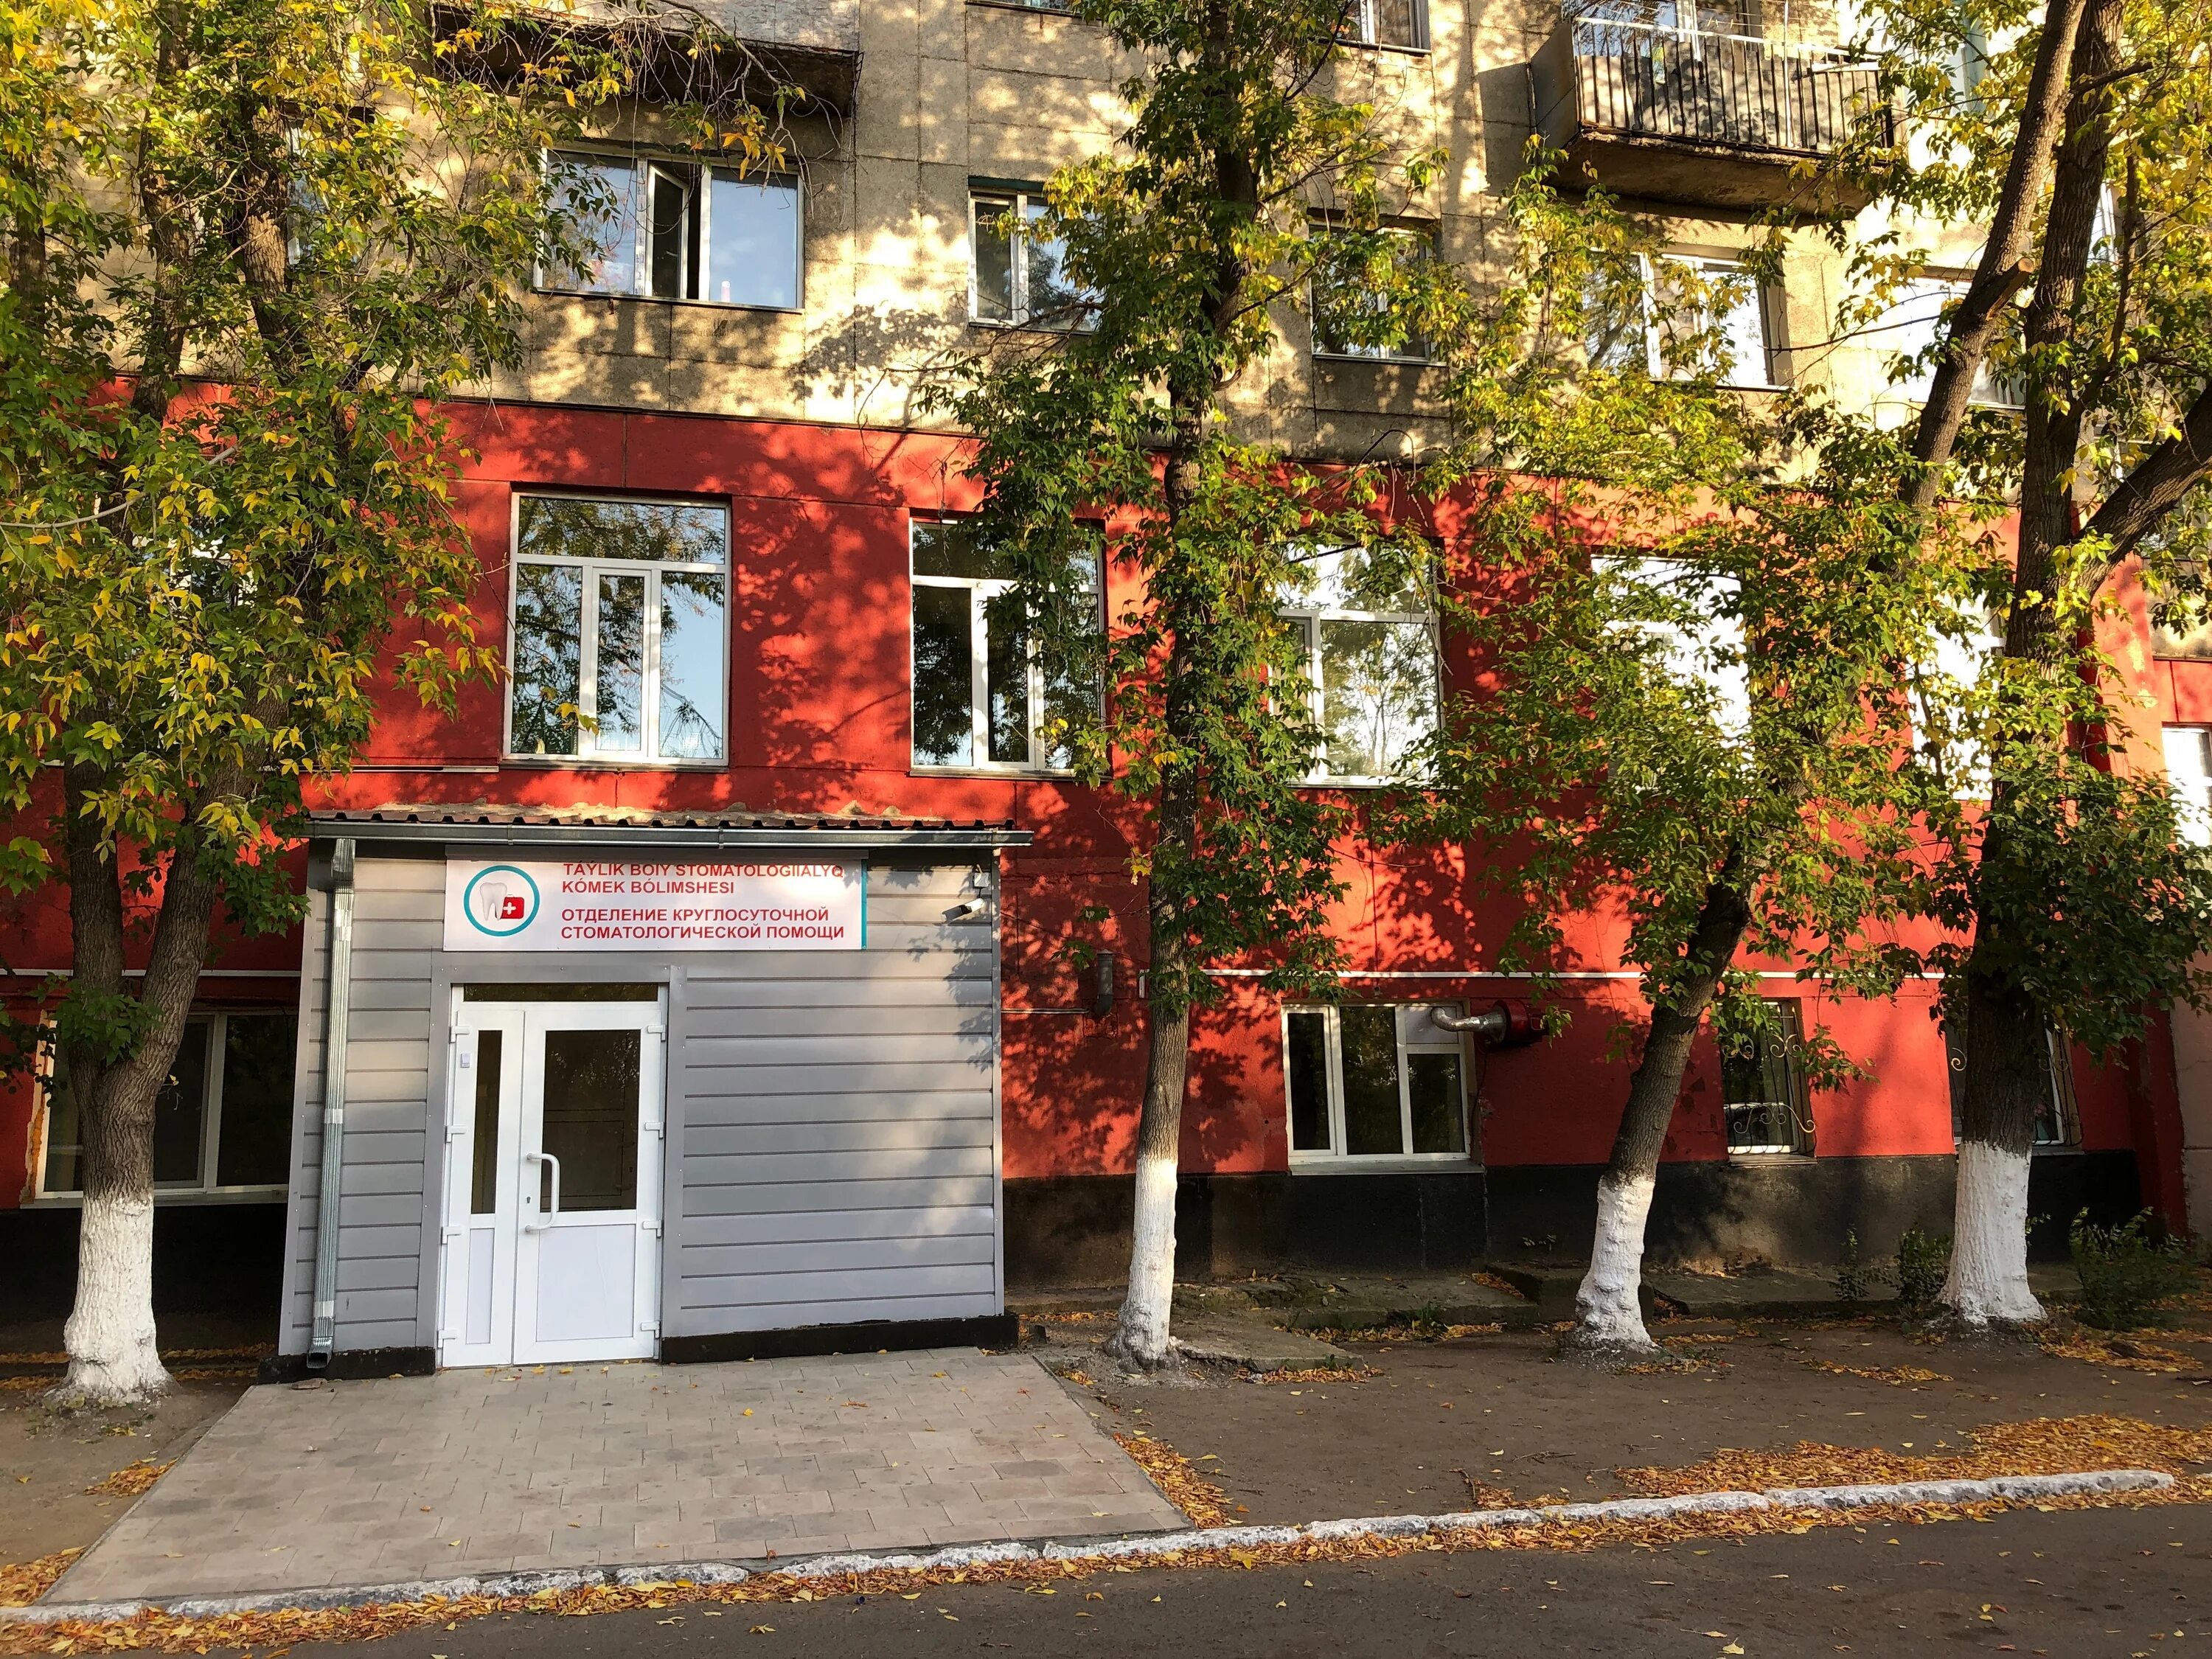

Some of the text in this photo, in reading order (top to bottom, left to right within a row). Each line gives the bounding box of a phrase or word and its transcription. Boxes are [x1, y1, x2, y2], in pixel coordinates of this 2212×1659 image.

[675, 863, 844, 878] STOMATOLOGIIALYQ
[562, 878, 734, 894] KÓMEK BÓLIMSHESI
[561, 905, 829, 923] ОТДЕЛЕНИЕ КРУГЛОСУТОЧНОЙ
[560, 922, 844, 941] СТОМАТОЛОГИЧЕСКОЙ ПОМОЩИ
